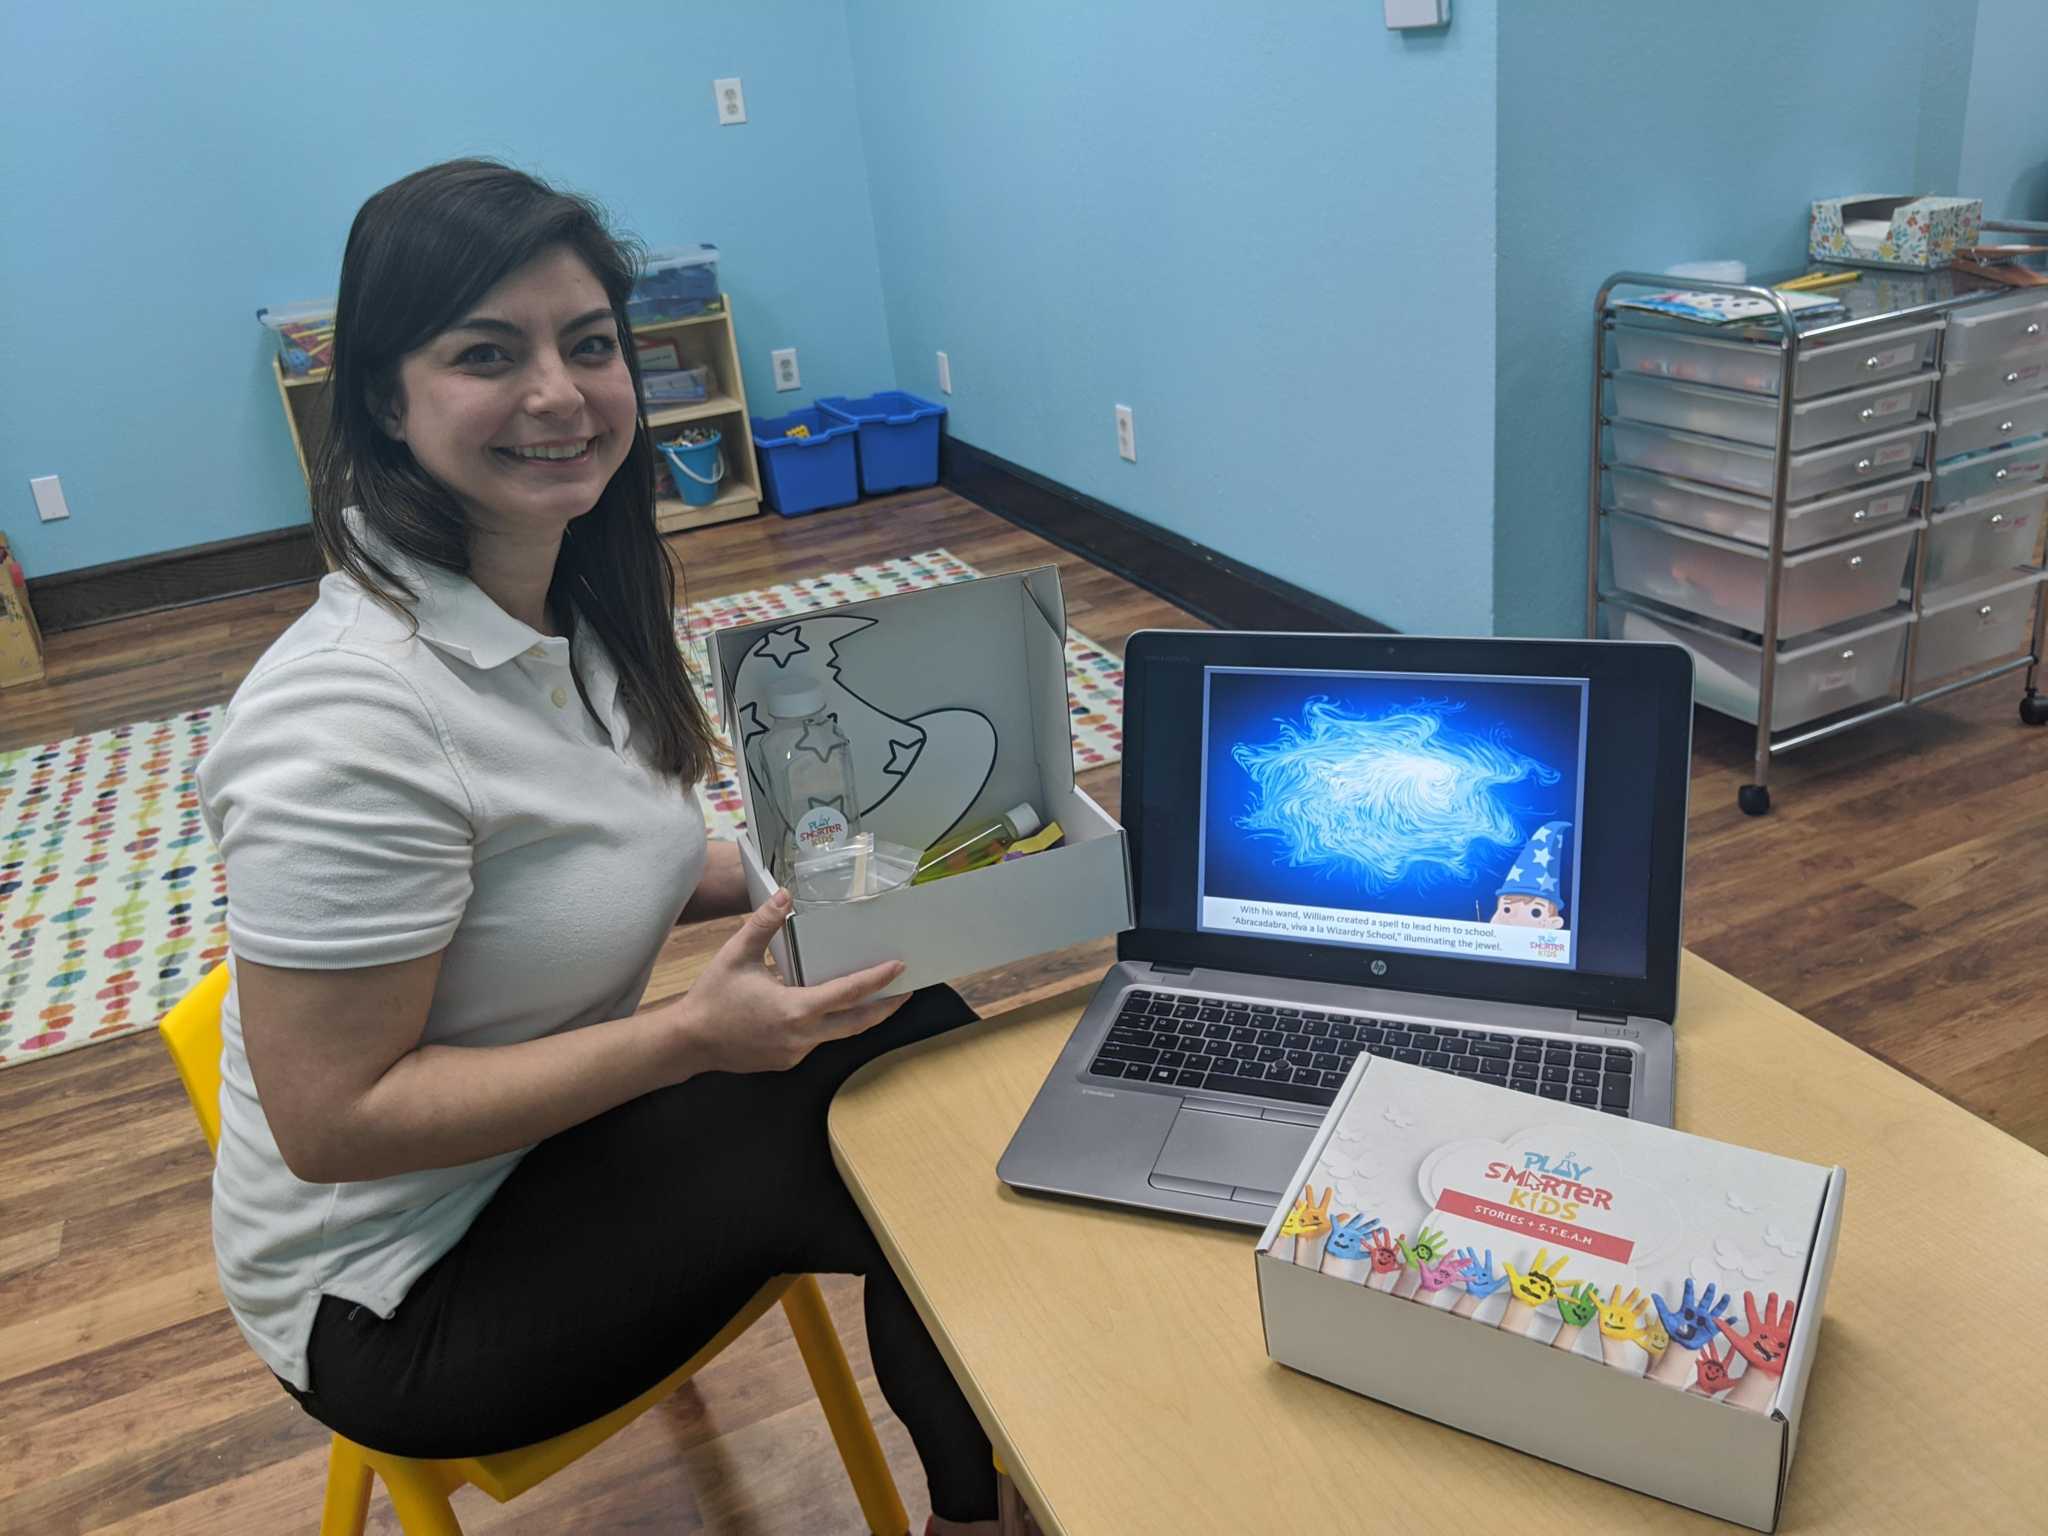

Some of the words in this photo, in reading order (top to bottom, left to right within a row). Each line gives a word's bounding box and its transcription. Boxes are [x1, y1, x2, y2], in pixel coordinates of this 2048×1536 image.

[1232, 915, 1289, 931] "Abracadabra,
[1291, 921, 1307, 931] viva
[1316, 924, 1324, 933] la
[1326, 925, 1365, 939] Wizardry
[1366, 928, 1401, 942] School,"
[1403, 932, 1456, 948] illuminating
[1458, 937, 1473, 948] the
[1474, 939, 1502, 952] jewel.
[1240, 905, 1260, 915] With
[1261, 906, 1274, 916] his
[1275, 908, 1300, 920] wand,
[1303, 911, 1335, 922] William
[1337, 914, 1369, 926] created
[1379, 918, 1399, 929] spell
[1401, 921, 1411, 930] to
[1412, 921, 1432, 932] lead
[1433, 923, 1451, 934] him
[1453, 926, 1463, 935] to
[1464, 926, 1497, 938] school.
[1524, 1152, 1592, 1181] PLAY
[1473, 1204, 1525, 1226] STORIES
